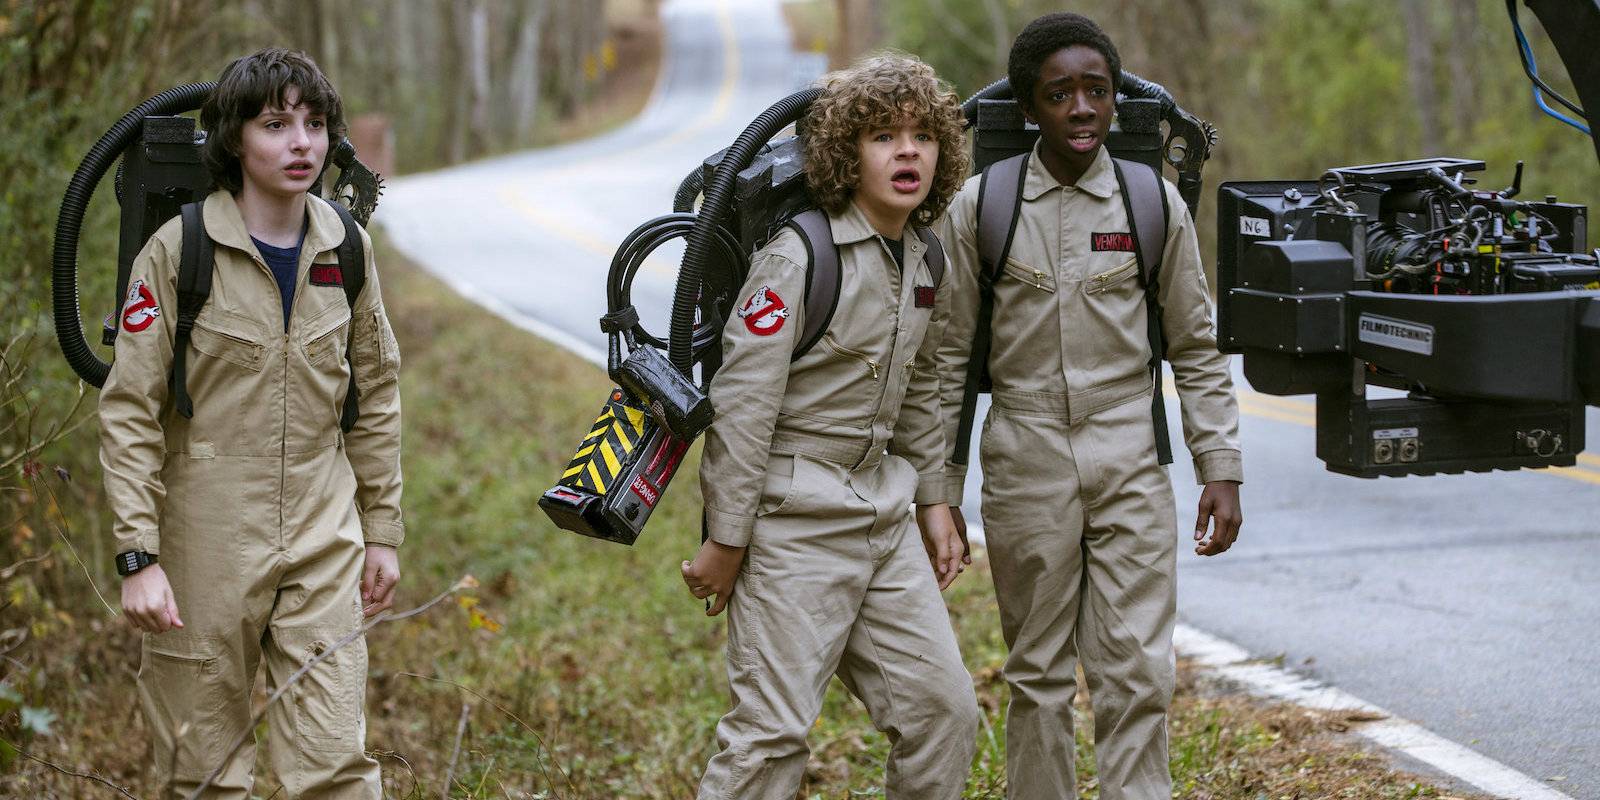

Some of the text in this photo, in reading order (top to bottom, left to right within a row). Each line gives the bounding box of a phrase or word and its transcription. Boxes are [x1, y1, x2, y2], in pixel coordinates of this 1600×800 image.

[1245, 220, 1262, 234] N6
[1361, 319, 1430, 342] FILMOTECHNIC
[633, 474, 657, 505] DANGER
